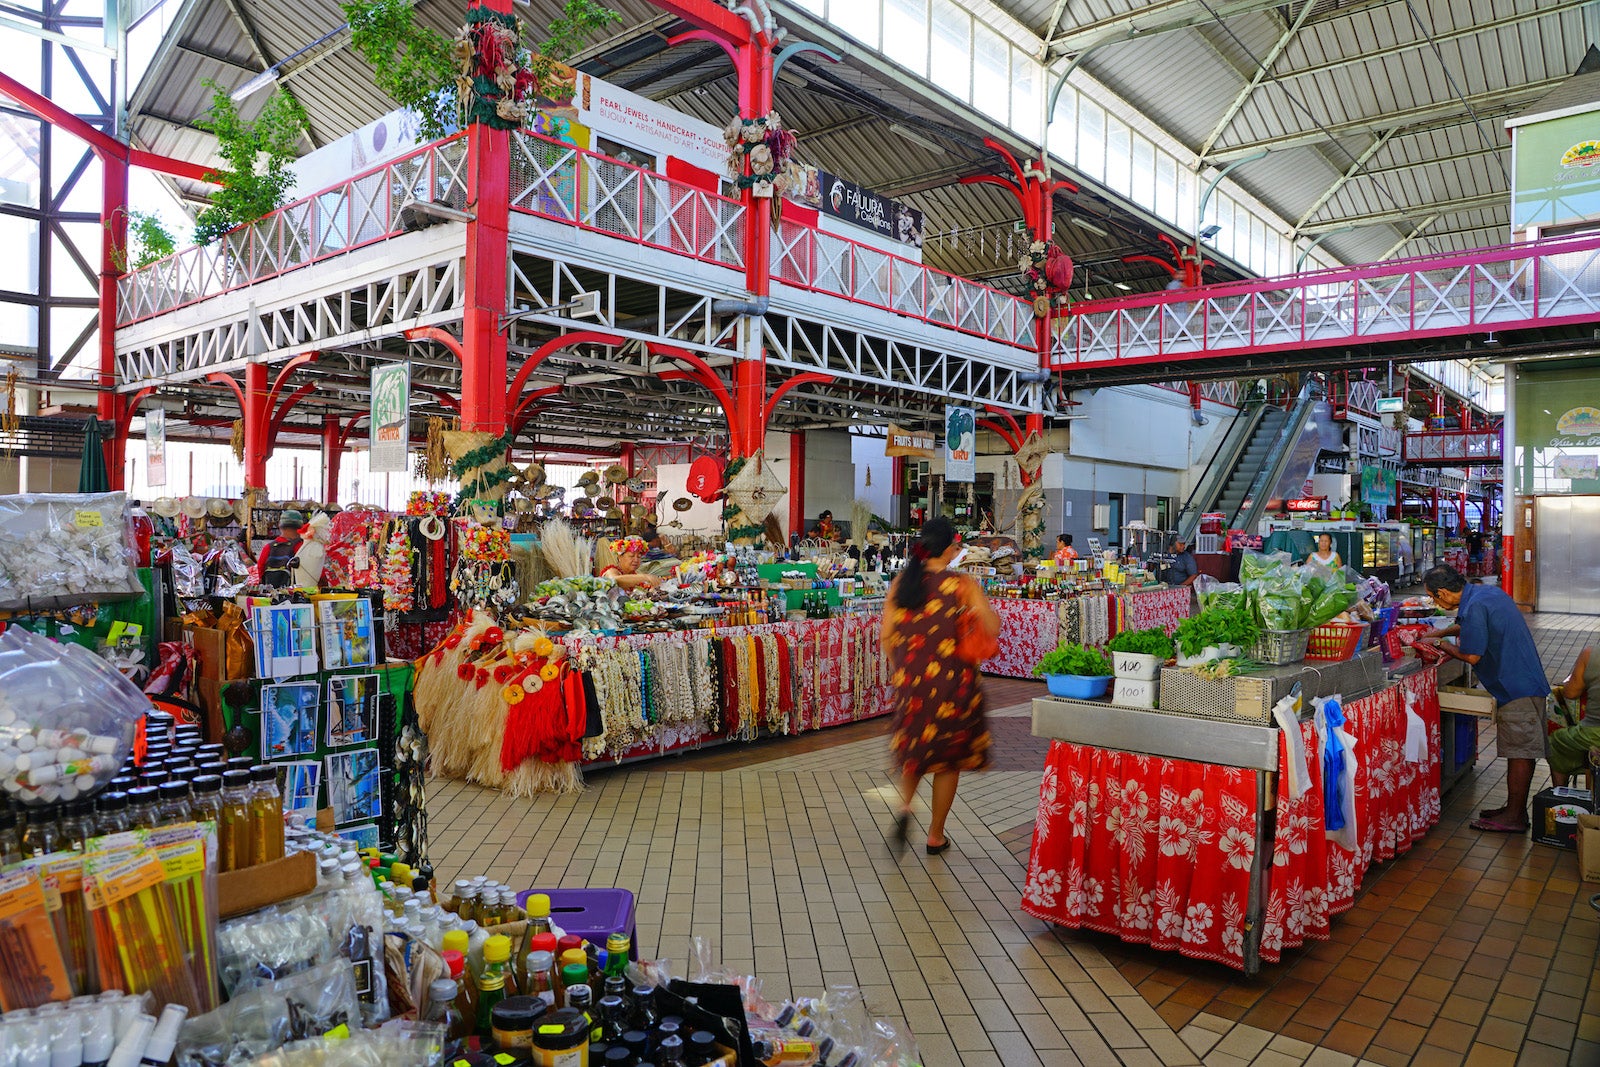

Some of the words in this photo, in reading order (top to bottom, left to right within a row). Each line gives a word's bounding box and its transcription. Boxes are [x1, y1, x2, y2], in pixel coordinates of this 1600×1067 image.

[600, 97, 622, 112] PEARL
[624, 106, 649, 122] JEWELS
[656, 119, 697, 140] HANDCRAFT
[599, 108, 627, 124] BIJOUX
[635, 122, 672, 143] ARTISANAT
[893, 435, 912, 447] FRUITS
[952, 450, 969, 461] URU
[1119, 660, 1141, 672] 100
